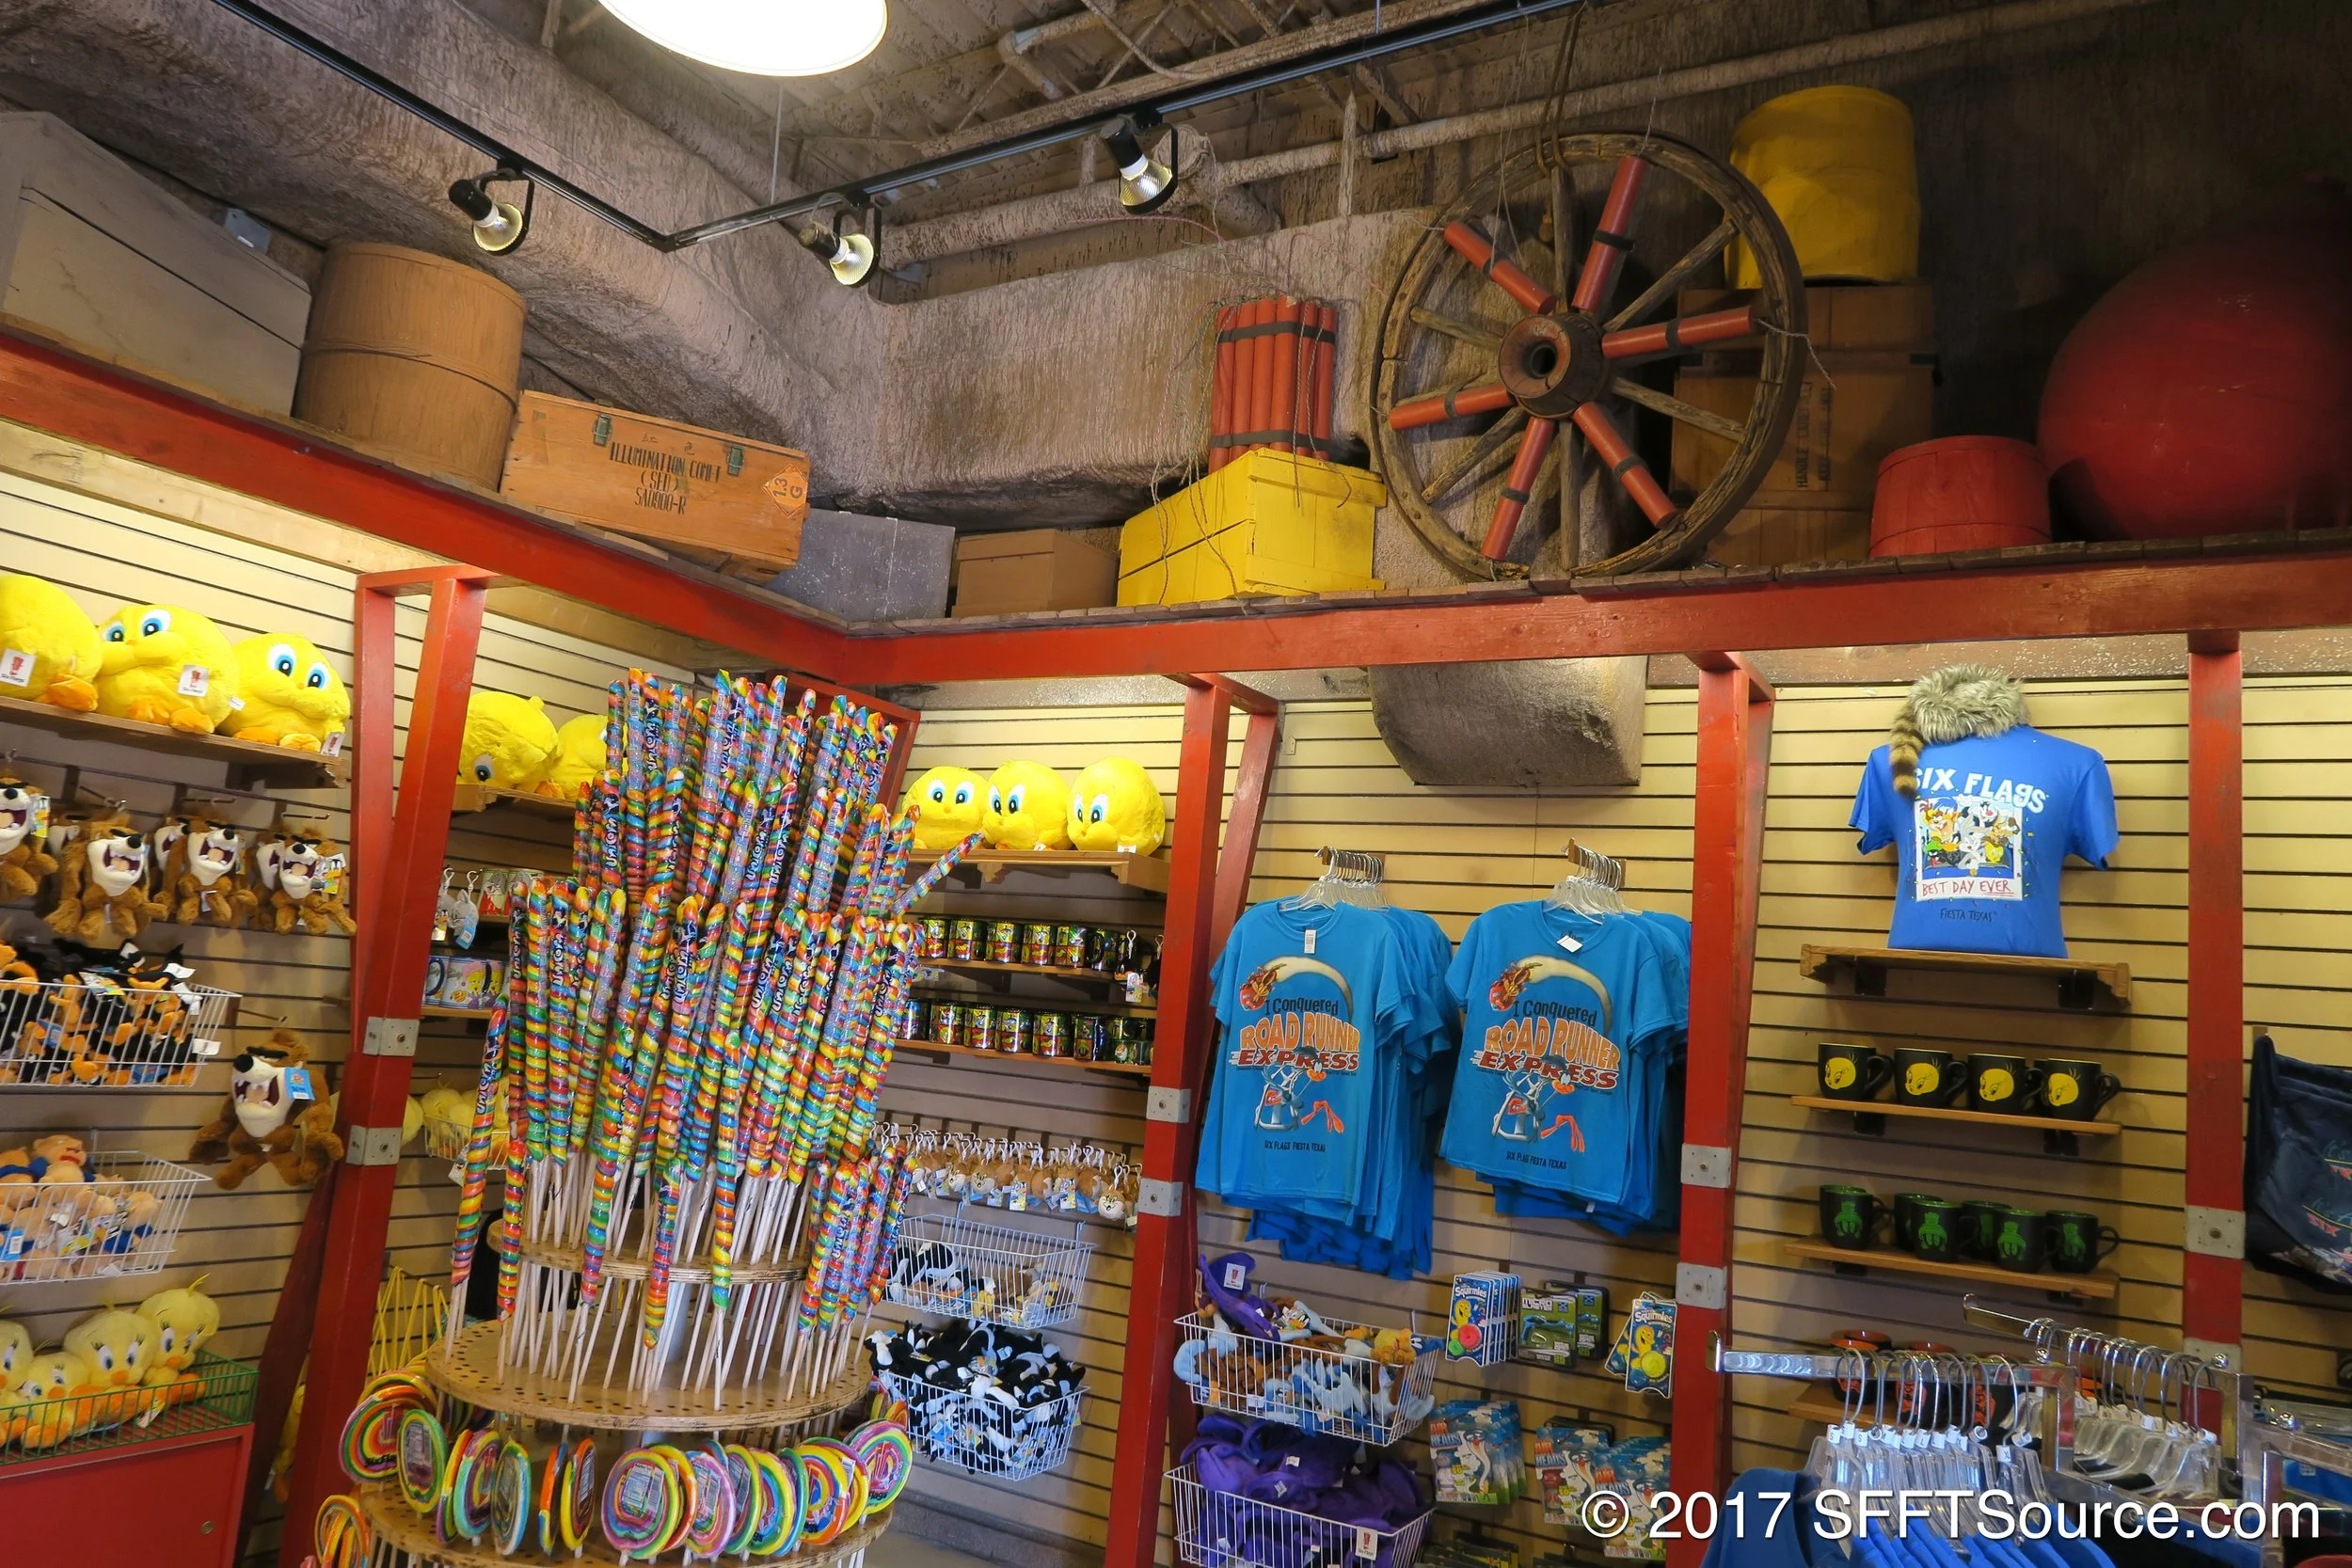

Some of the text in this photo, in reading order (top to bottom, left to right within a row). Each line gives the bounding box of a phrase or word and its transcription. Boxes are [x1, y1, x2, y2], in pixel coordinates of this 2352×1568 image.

[609, 441, 685, 477] ILLUMINATION
[789, 485, 803, 499] G
[1915, 768, 1957, 792] SIX
[1922, 879, 2012, 896] BEST DAY EVER
[1940, 908, 1993, 923] FIESTA TEXAS
[1264, 997, 1340, 1016] I Conquered
[1513, 999, 1597, 1027] I Conquered
[1240, 1011, 1361, 1052] ROAD RUNNER
[1485, 1016, 1621, 1070] ROAD RUNNER
[1236, 1049, 1360, 1071] EXPRESS
[1478, 1050, 1620, 1090] EXPRESS
[1274, 1140, 1291, 1150] FLAGS
[1292, 1141, 1311, 1151] FIESTA
[1530, 1154, 1547, 1166] FIESTA
[1549, 1158, 1567, 1170] TEXAS
